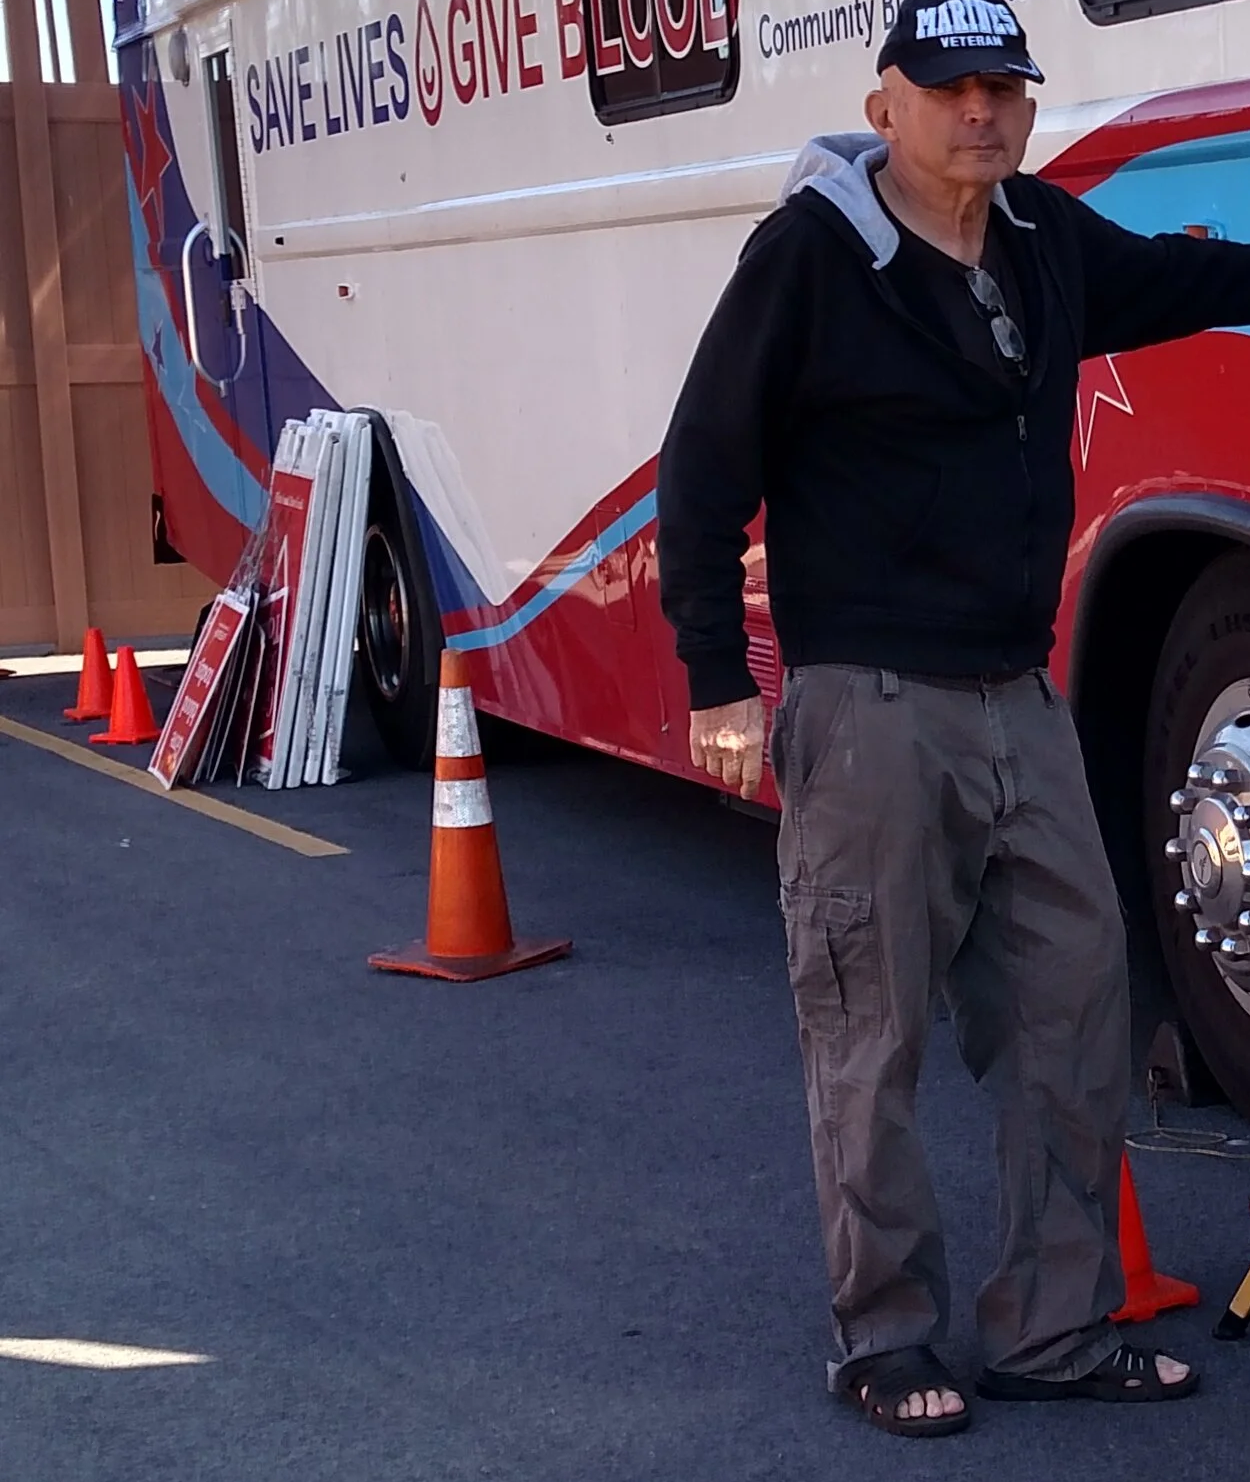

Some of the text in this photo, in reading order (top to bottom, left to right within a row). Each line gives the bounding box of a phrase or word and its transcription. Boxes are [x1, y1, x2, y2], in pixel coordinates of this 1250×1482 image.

[940, 35, 1004, 48] VETERAN
[247, 45, 317, 154] SAVE
[319, 13, 410, 136] LIVES
